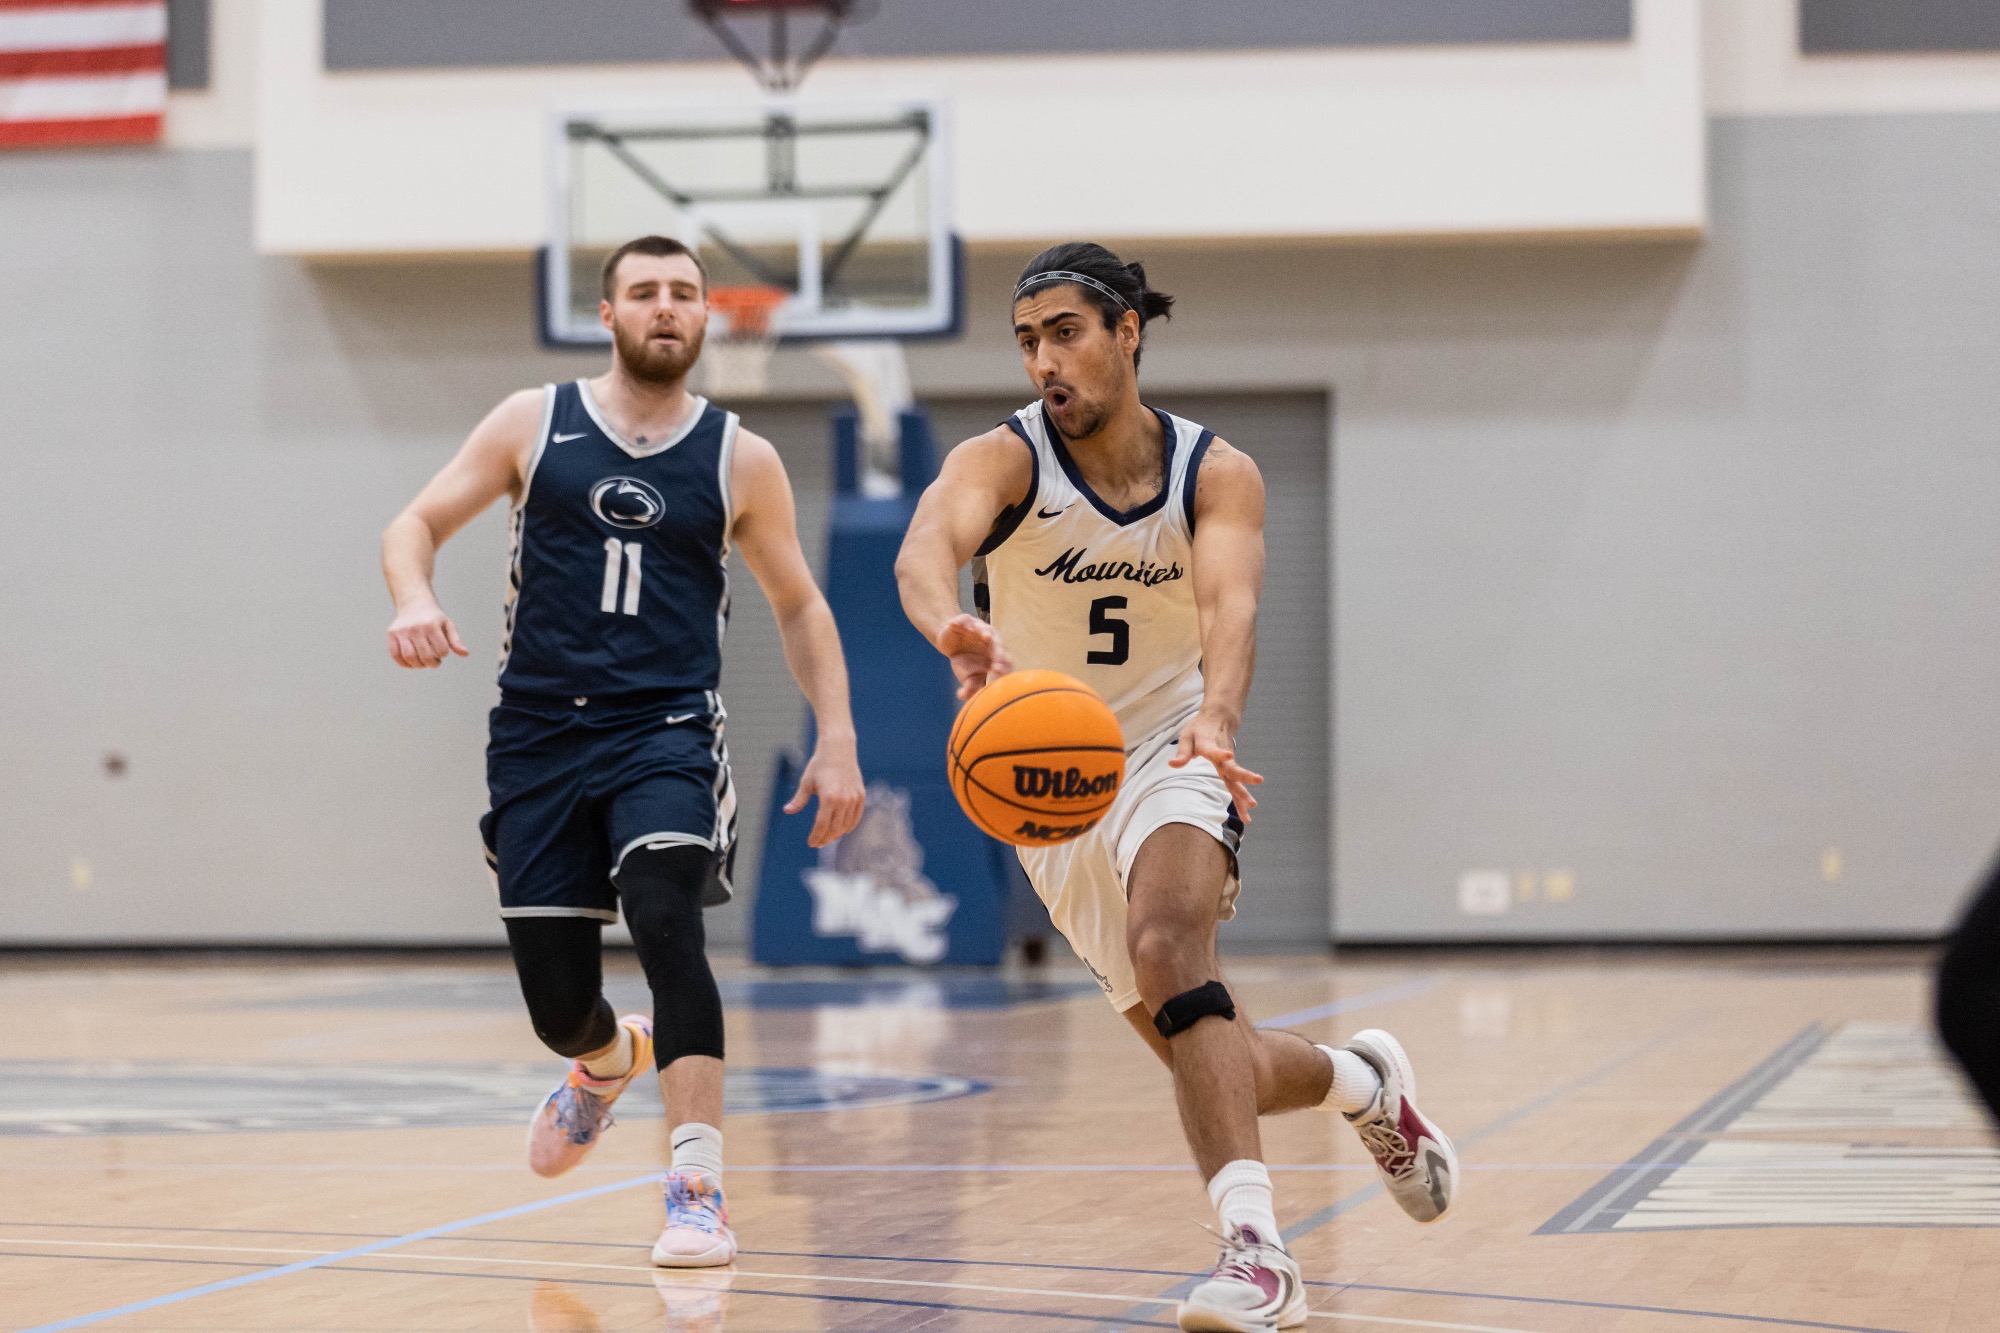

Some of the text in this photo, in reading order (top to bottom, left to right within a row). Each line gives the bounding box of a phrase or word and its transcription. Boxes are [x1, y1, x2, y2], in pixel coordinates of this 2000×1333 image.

[601, 537, 642, 616] 11
[1087, 595, 1129, 665] 5
[1013, 764, 1118, 798] Wilson
